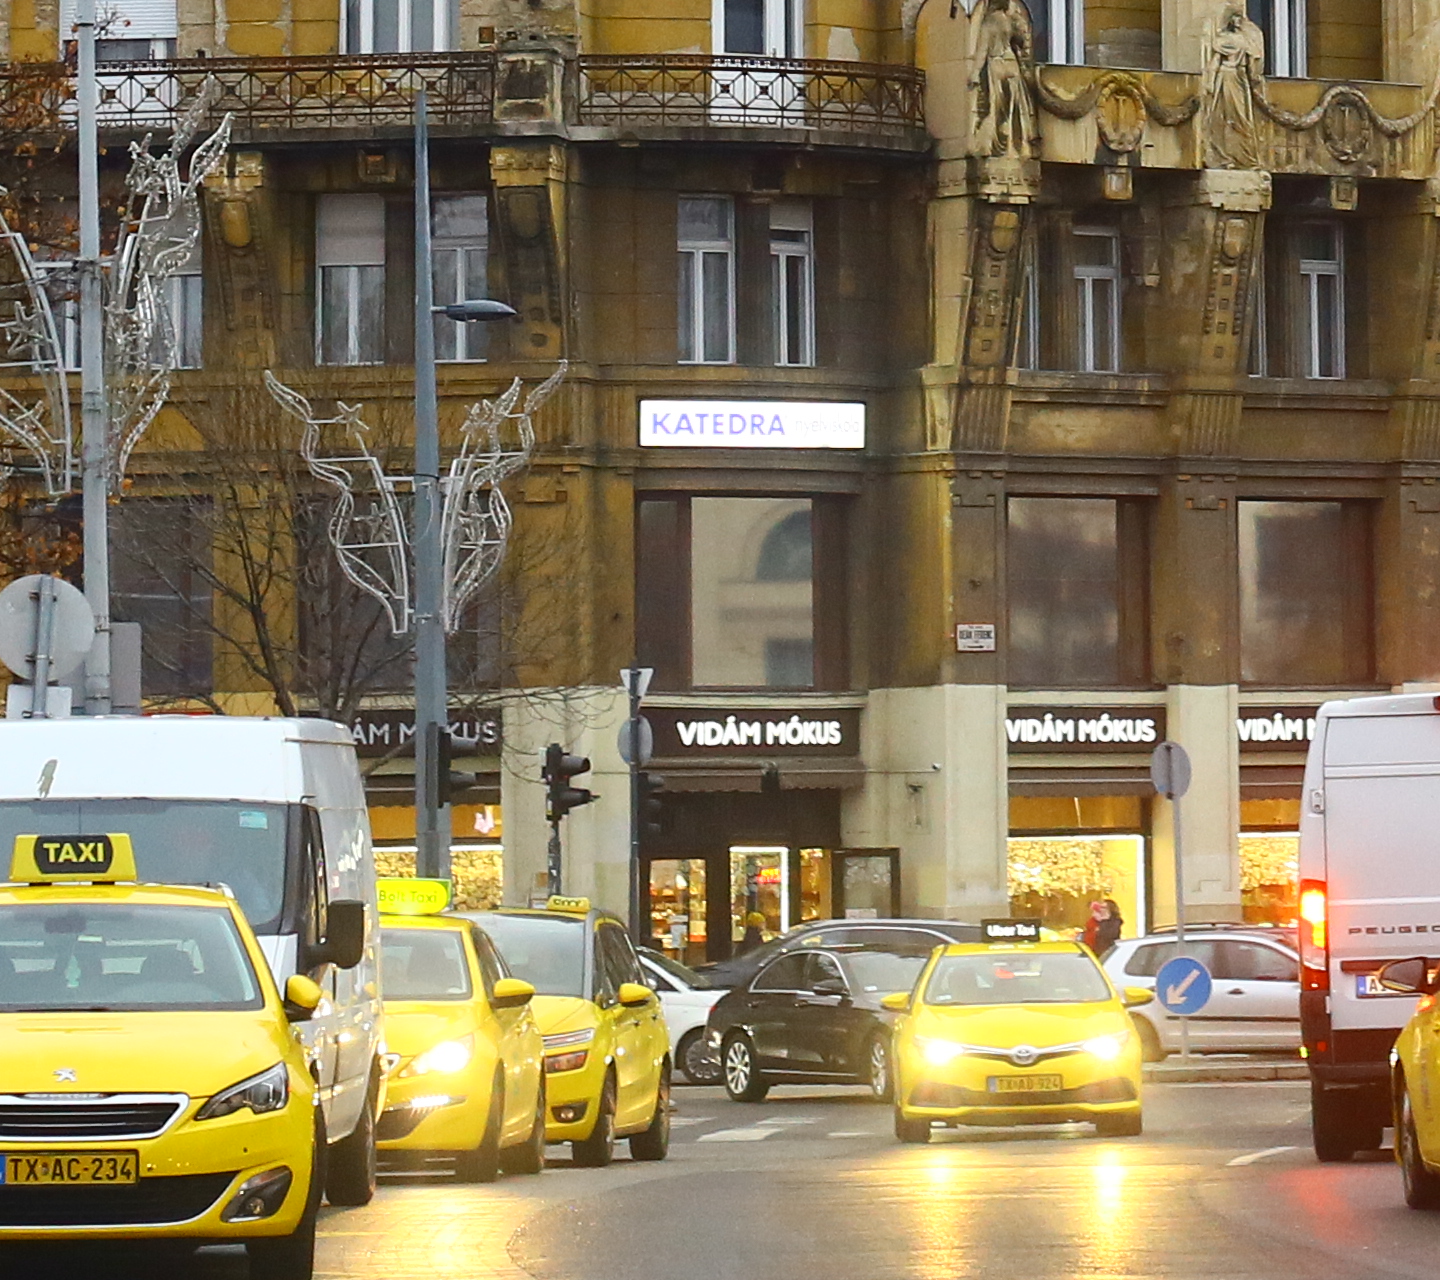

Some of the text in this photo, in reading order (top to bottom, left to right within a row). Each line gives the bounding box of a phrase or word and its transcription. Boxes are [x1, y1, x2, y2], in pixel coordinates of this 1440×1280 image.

[652, 412, 786, 436] KATEDRA
[676, 715, 842, 746] VIDÁM MÓKUS
[1005, 713, 1157, 743] VIDÁM MÓKUS
[1236, 712, 1303, 741] VIDÁM
[42, 842, 105, 863] TAXI
[379, 890, 438, 904] Bolt Taxi
